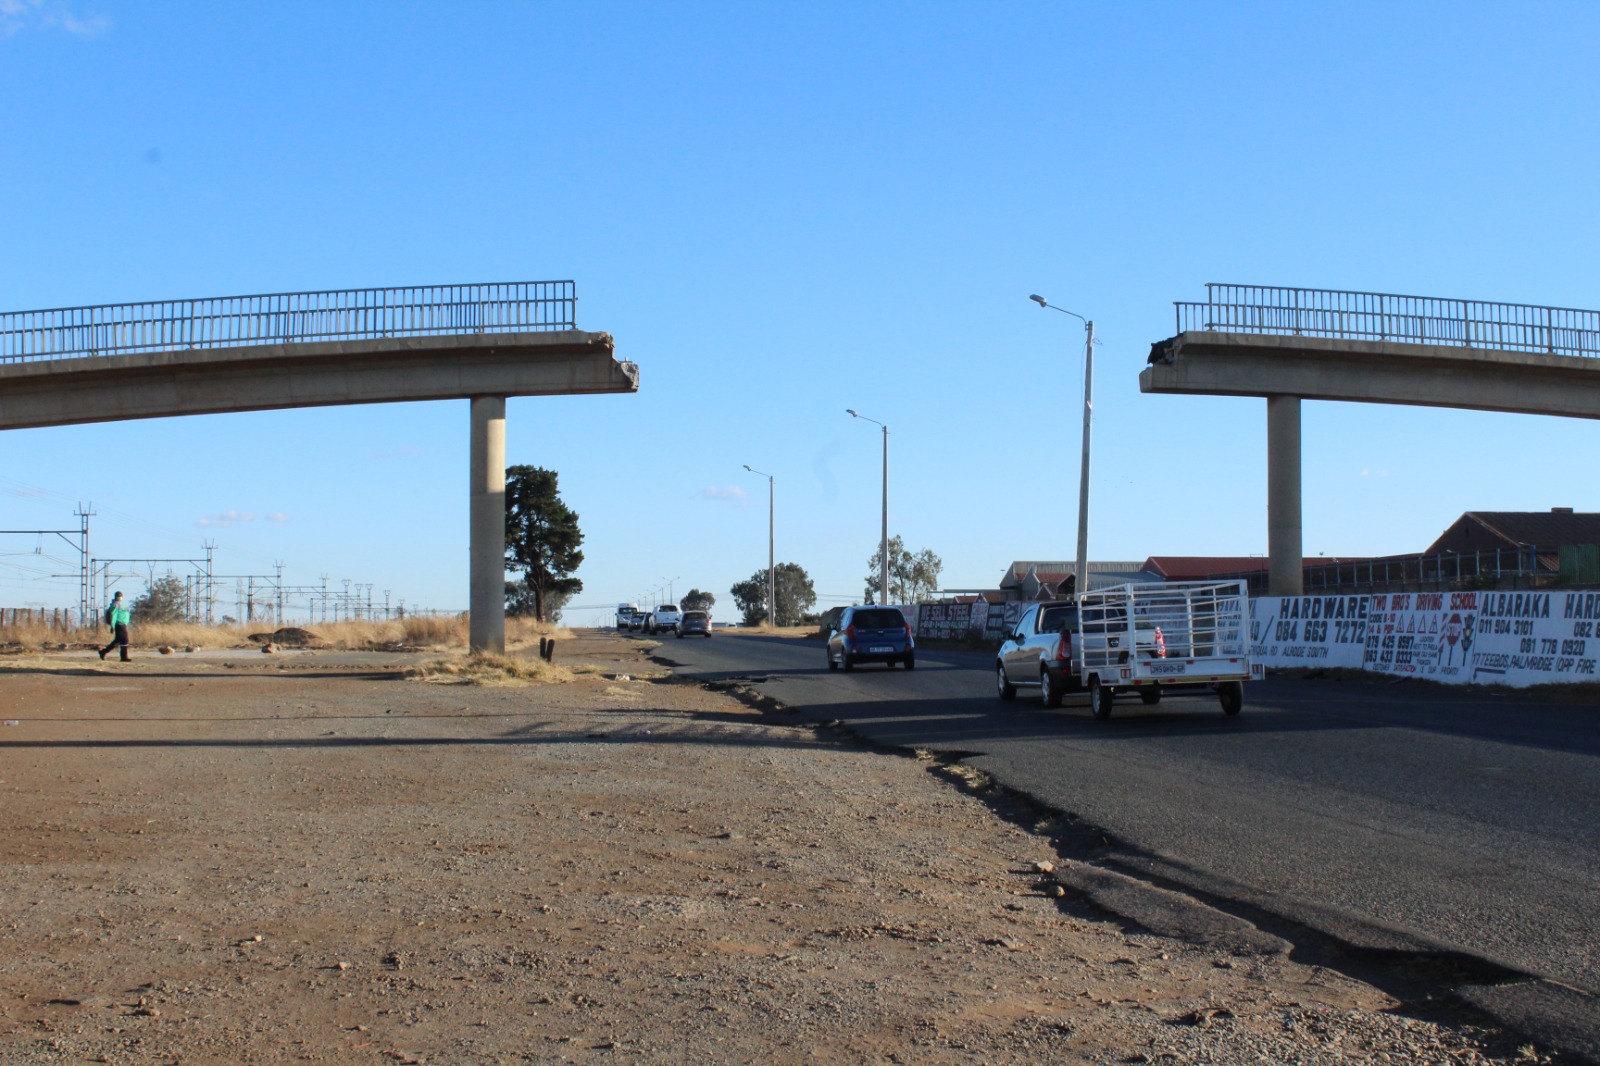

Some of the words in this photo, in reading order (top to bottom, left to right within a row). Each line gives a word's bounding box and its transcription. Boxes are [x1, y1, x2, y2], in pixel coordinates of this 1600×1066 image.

[1280, 596, 1370, 619] HARDWARE
[1372, 595, 1387, 611] TWO
[1416, 593, 1444, 611] DRIVING
[1450, 592, 1478, 610] SCHOOL
[1481, 593, 1551, 618] ALBARAKA
[933, 605, 947, 620] SELL
[949, 604, 970, 620] STEEL
[1276, 620, 1299, 641] 084
[1304, 620, 1328, 642] 663
[1335, 620, 1367, 643] 7272
[1479, 619, 1492, 634] 011
[1494, 619, 1511, 635] 904
[1514, 620, 1533, 636] 3101
[1574, 621, 1593, 638] 082
[1367, 635, 1379, 649] 079
[1382, 635, 1395, 649] 425
[1520, 638, 1536, 653] 081
[1541, 638, 1558, 654] 778
[1561, 639, 1586, 656] 0920
[1307, 647, 1330, 659] SOUTH
[1380, 650, 1393, 663] 433
[1575, 659, 1597, 674] FIRE
